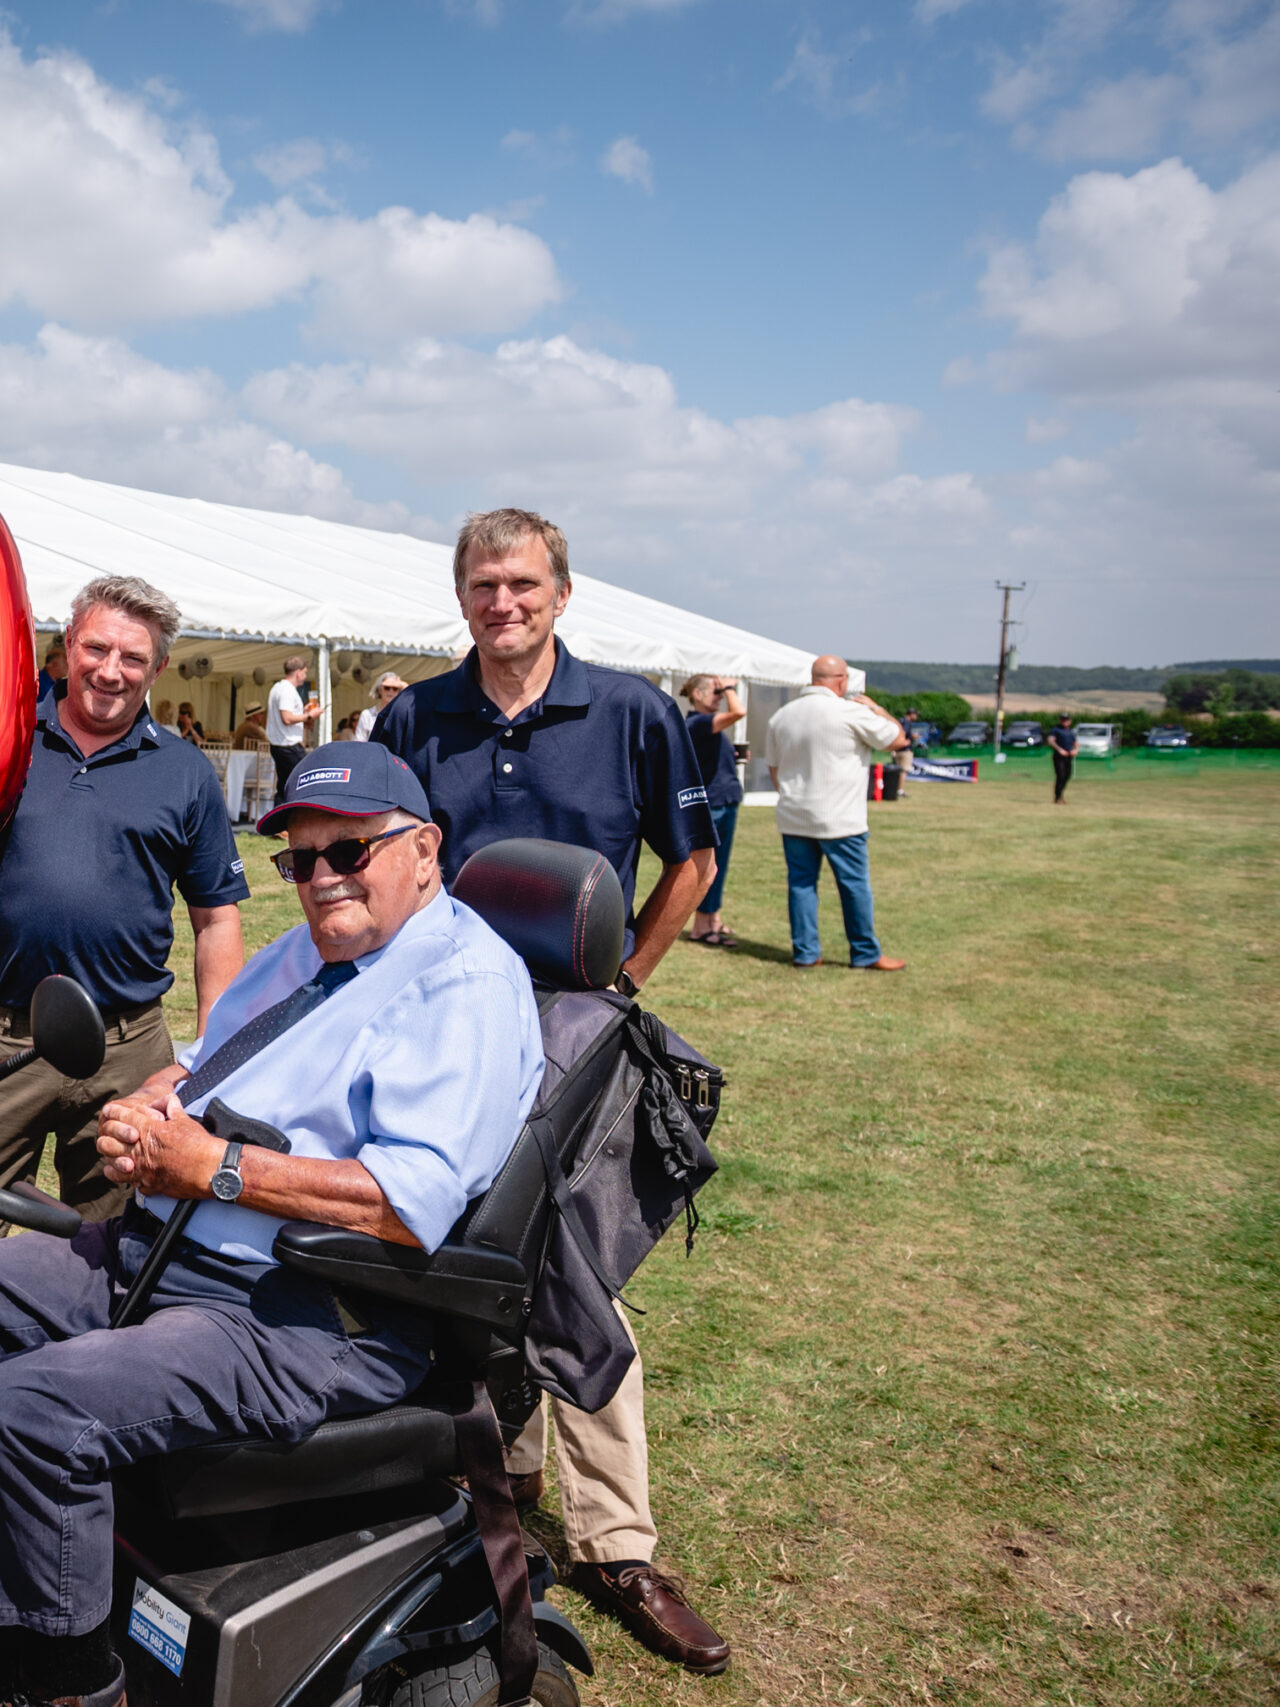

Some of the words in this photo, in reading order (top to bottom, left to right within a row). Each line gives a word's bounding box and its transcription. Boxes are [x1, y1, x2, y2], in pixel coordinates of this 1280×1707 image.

[300, 775, 310, 784] MJ
[310, 772, 343, 780] ABBOTT
[681, 792, 692, 802] MJ
[136, 1587, 164, 1620] Mobility
[166, 1611, 186, 1635] Giant
[131, 1619, 149, 1639] 0800
[165, 1645, 181, 1666] 1170
